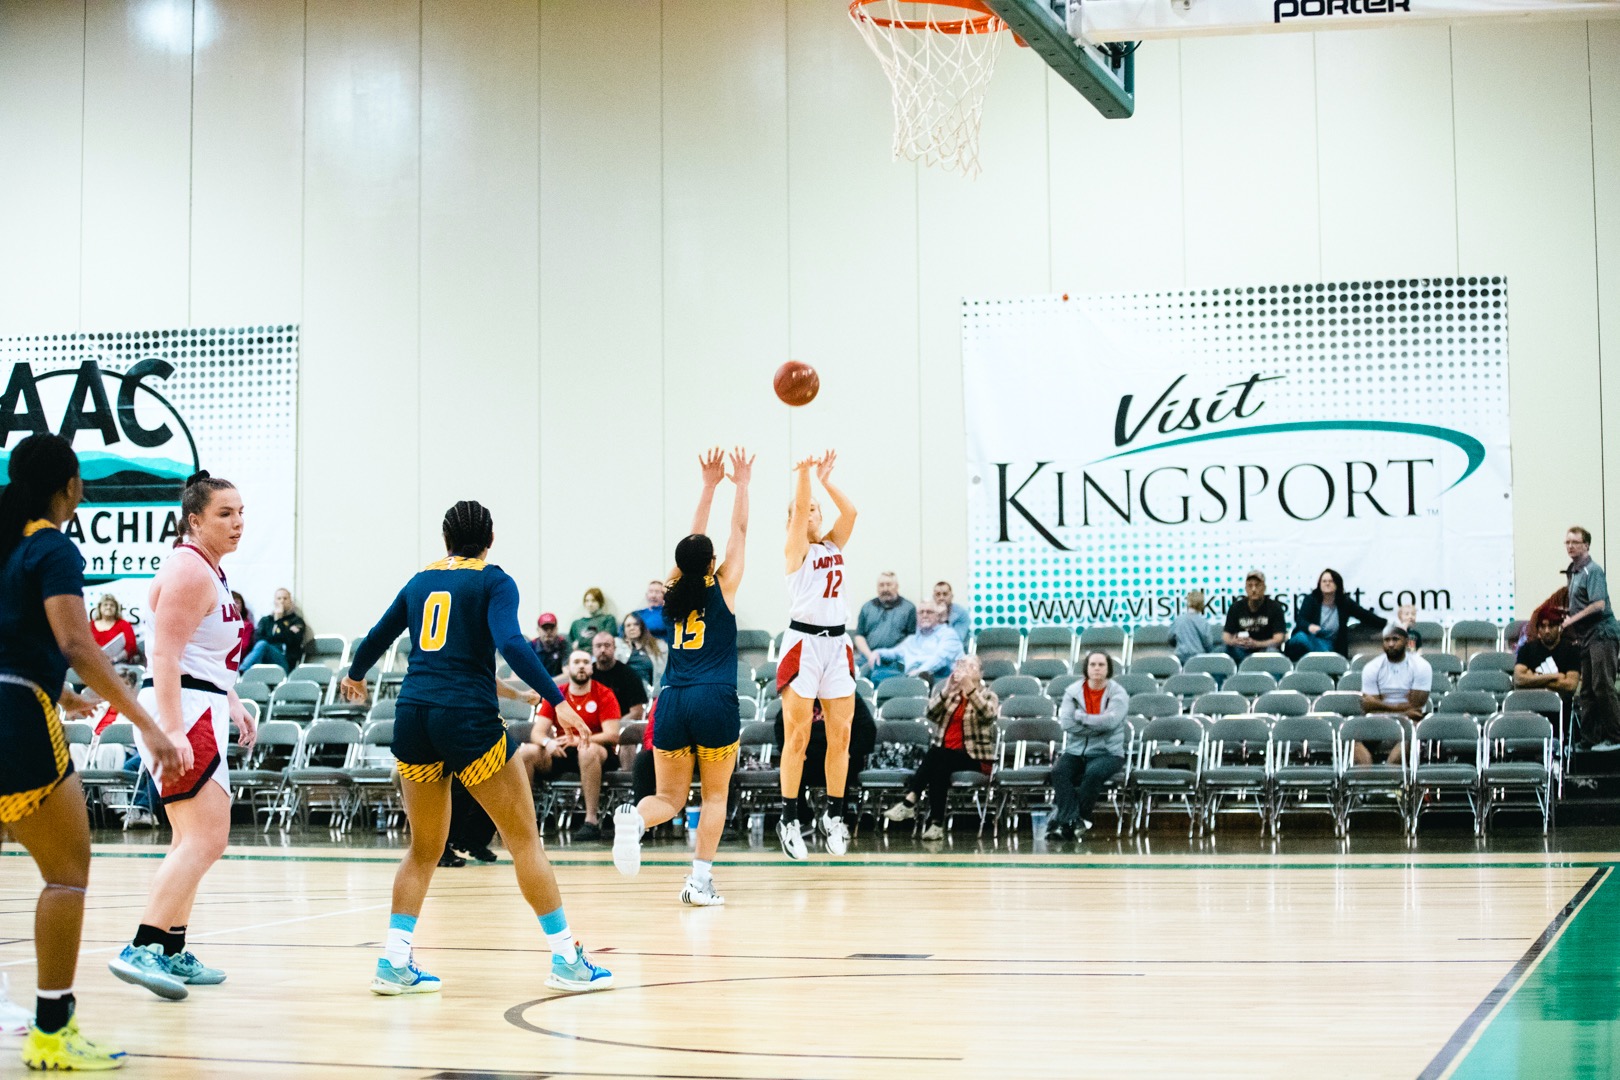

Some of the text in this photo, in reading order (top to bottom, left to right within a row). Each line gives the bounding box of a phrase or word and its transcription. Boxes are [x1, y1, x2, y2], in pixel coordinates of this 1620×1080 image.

[0, 358, 175, 447] AAC
[1114, 373, 1287, 447] Visit
[65, 510, 178, 544] ACHIA
[990, 458, 1434, 551] KINGSPORT
[823, 570, 843, 598] 12
[419, 591, 452, 651] 0
[672, 608, 706, 650] 15
